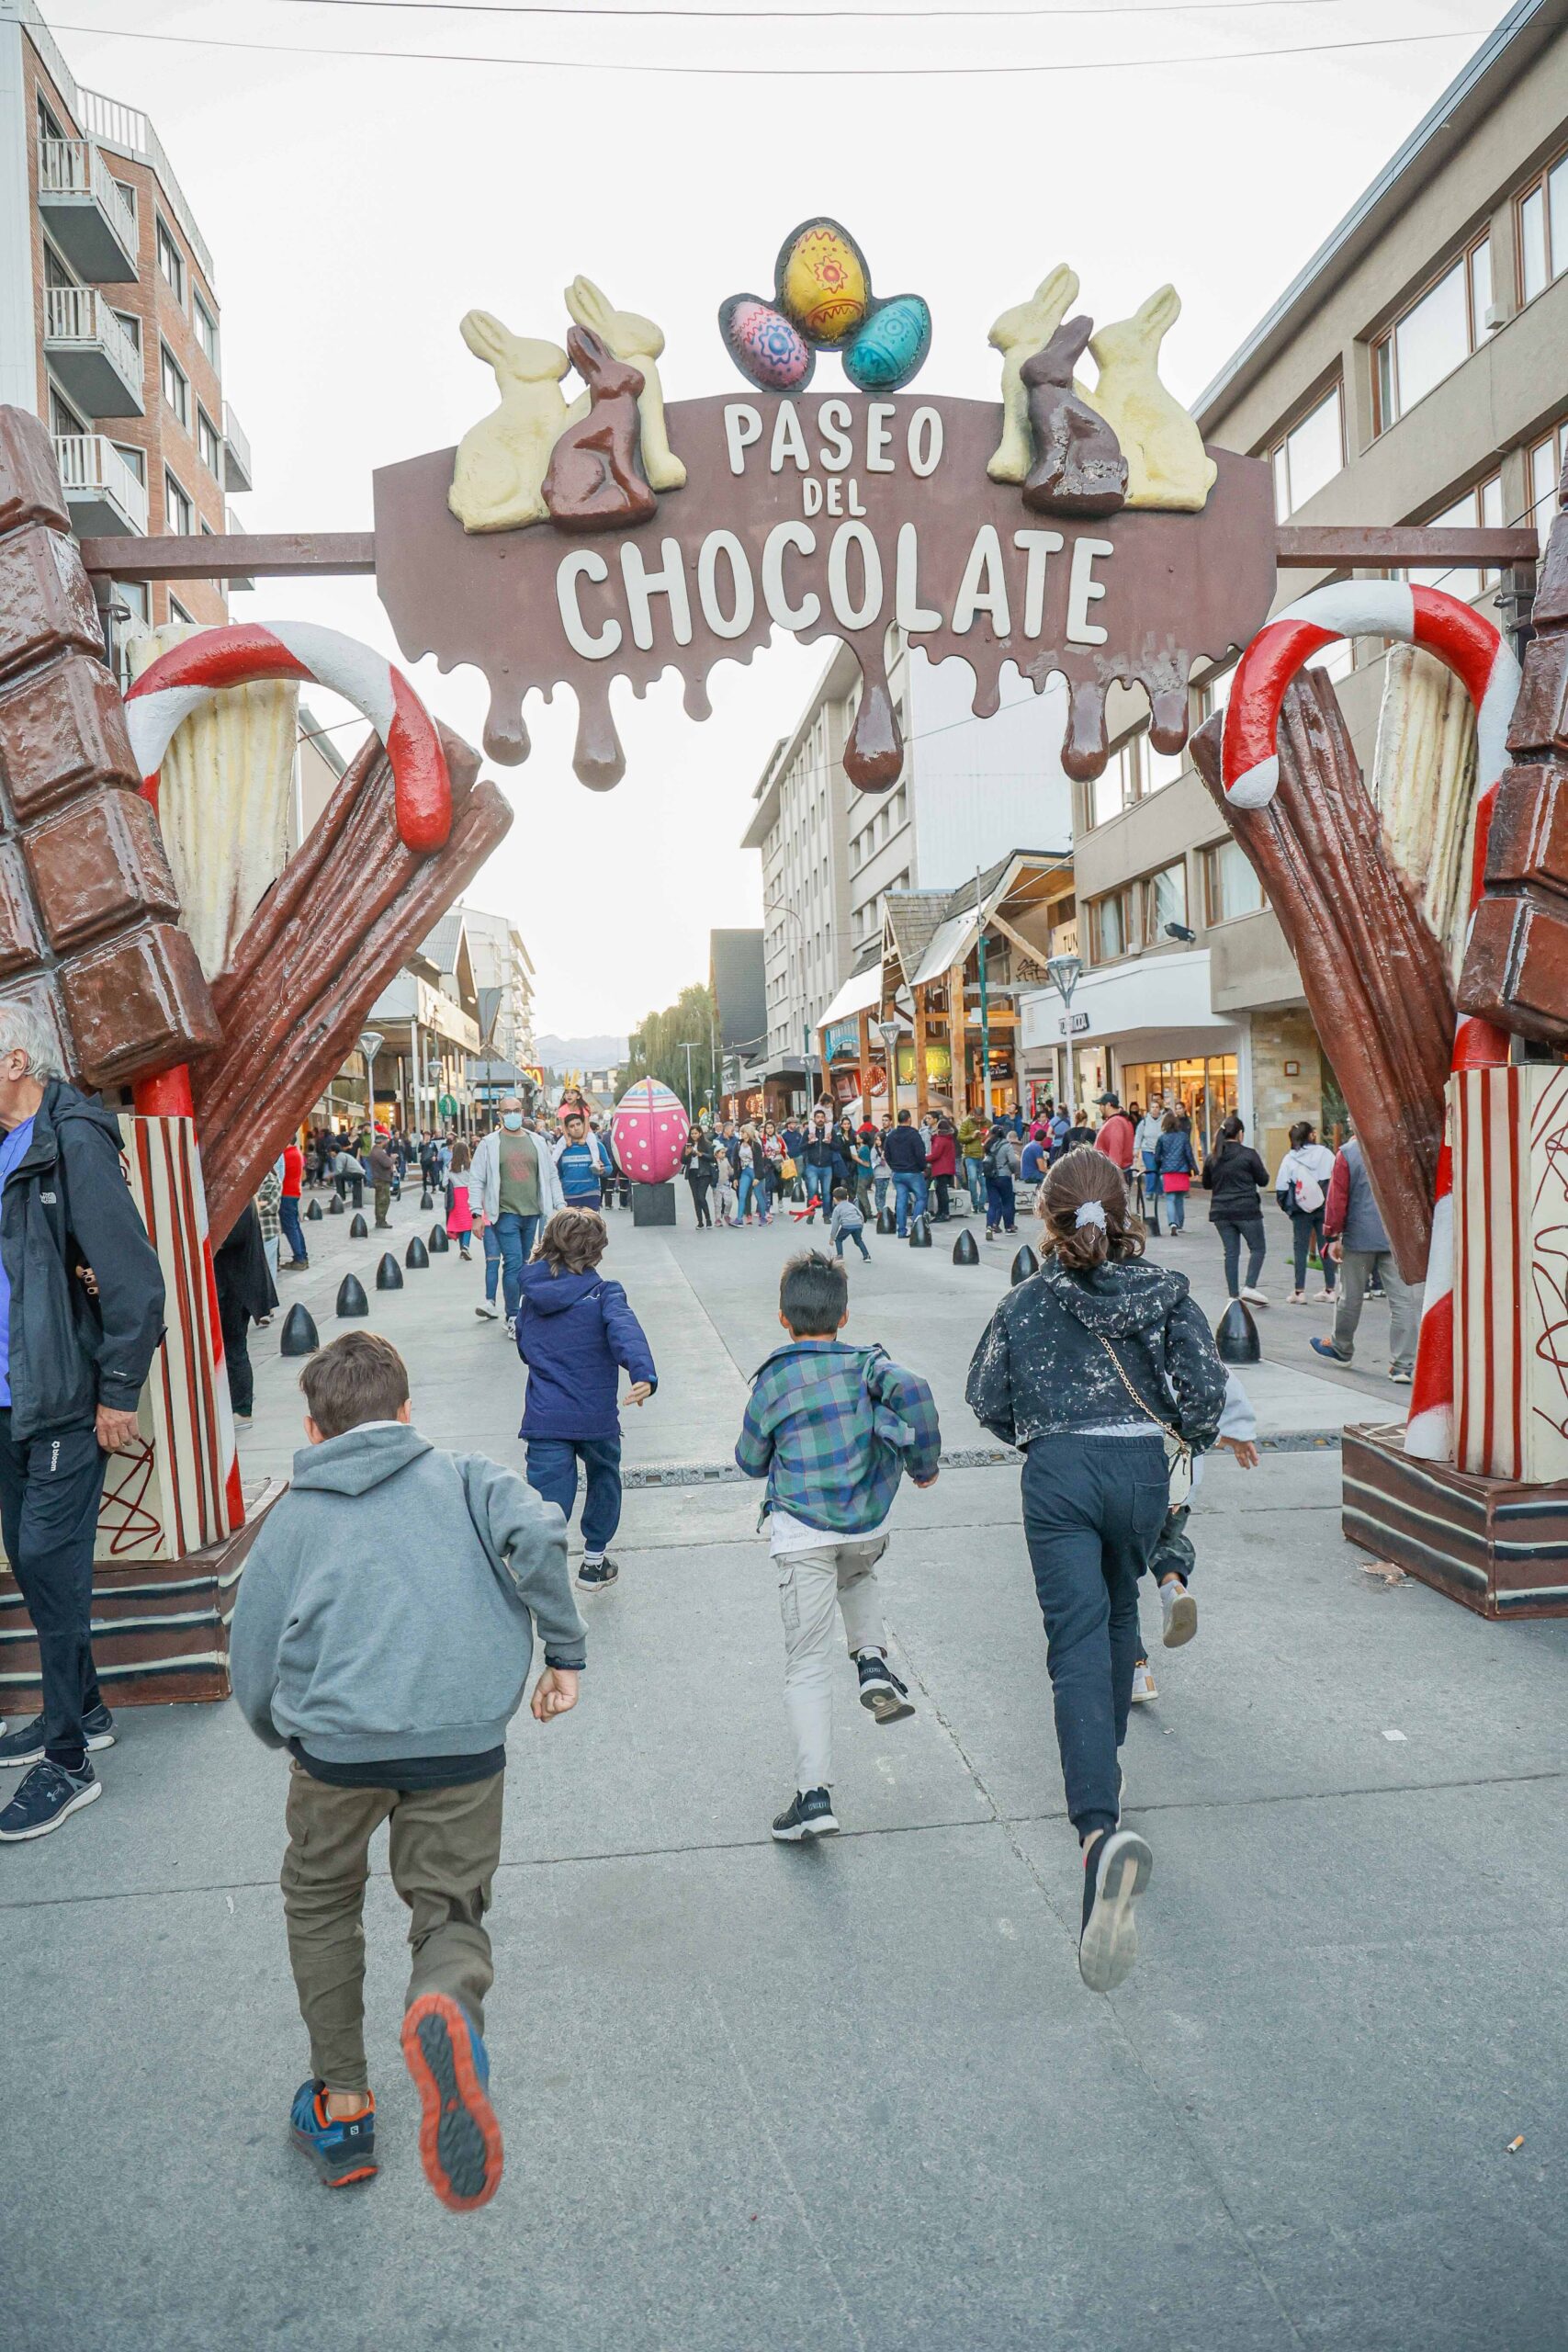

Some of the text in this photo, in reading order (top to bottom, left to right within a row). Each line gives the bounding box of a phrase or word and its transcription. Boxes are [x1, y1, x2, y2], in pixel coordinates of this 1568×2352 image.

[724, 399, 943, 477] PASEO
[803, 478, 866, 517] DEL
[556, 521, 1114, 660] CHOCOLATE
[51, 1449, 59, 1472] bloom
